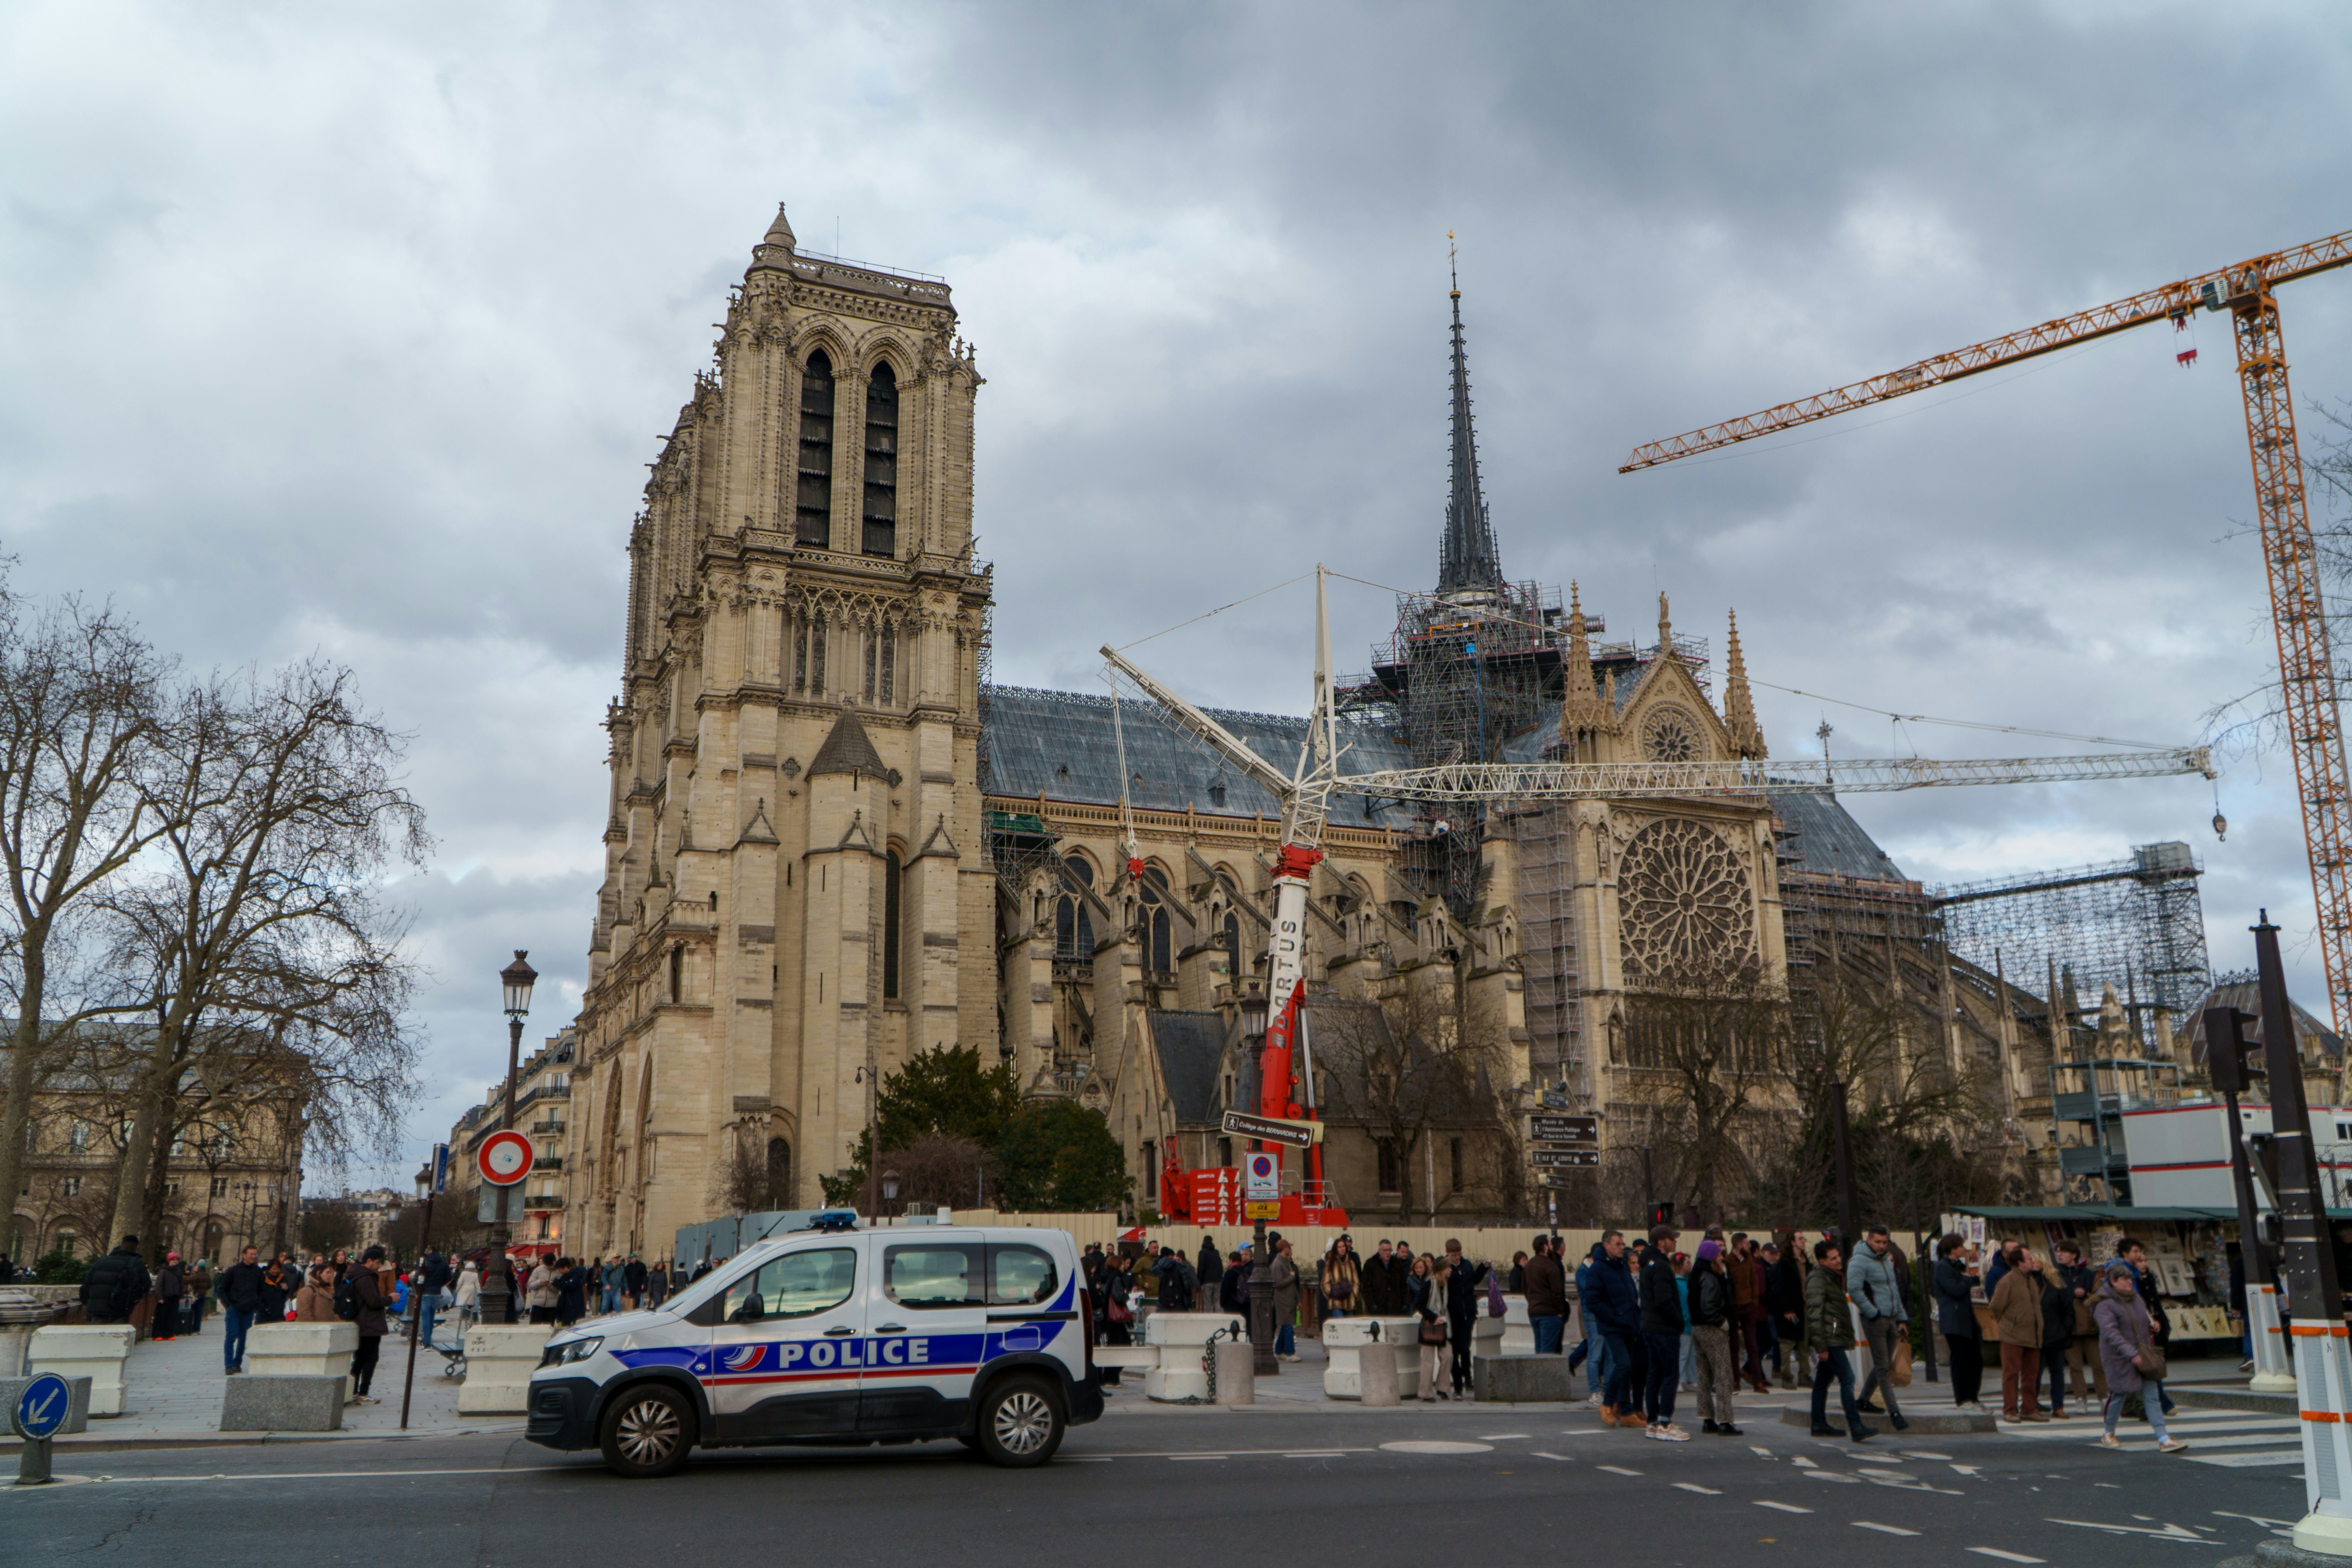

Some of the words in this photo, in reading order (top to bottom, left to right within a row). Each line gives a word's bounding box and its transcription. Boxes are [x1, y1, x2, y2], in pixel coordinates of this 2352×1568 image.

[1239, 1122, 1256, 1131] Collège
[1266, 1127, 1298, 1138] BERNARDINS
[779, 1339, 928, 1368] POLICE
